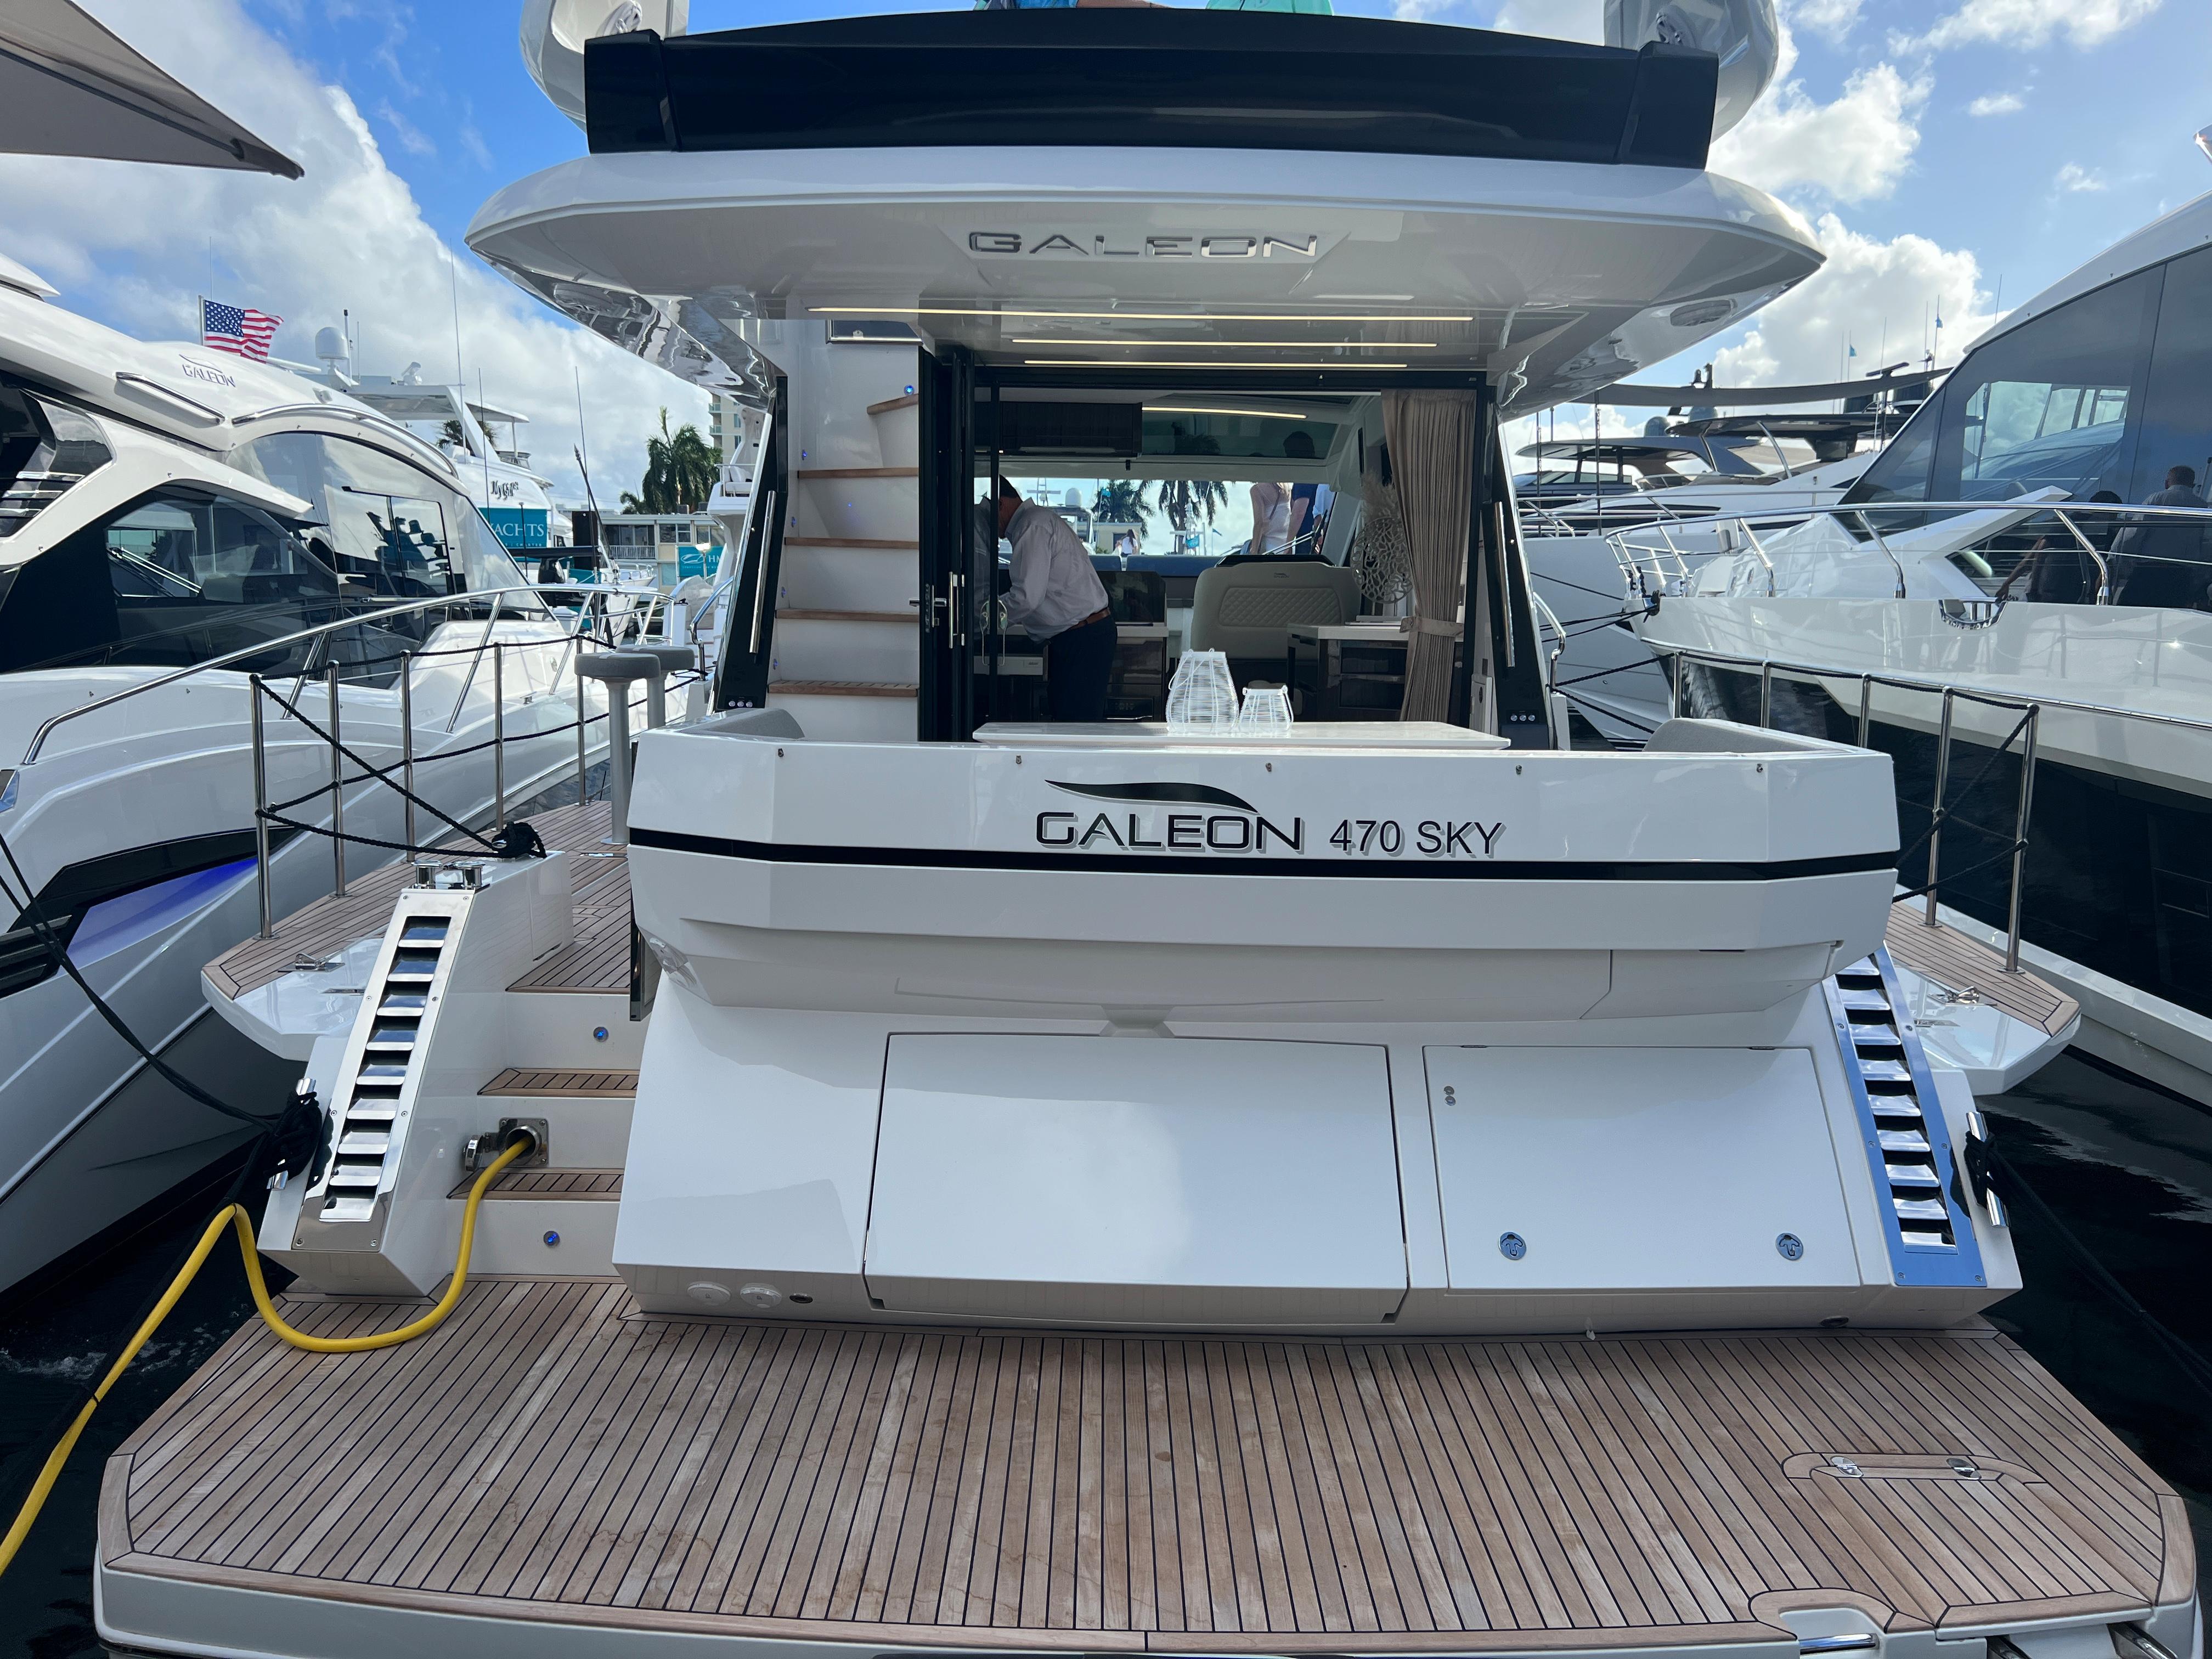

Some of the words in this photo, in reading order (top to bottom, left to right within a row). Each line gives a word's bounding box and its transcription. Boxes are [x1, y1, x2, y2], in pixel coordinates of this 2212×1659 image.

[968, 232, 1317, 258] GALEON
[182, 364, 236, 387] GALEON
[1036, 811, 1304, 854] GALEON
[1329, 819, 1404, 856] 470
[1416, 821, 1506, 858] SKY
